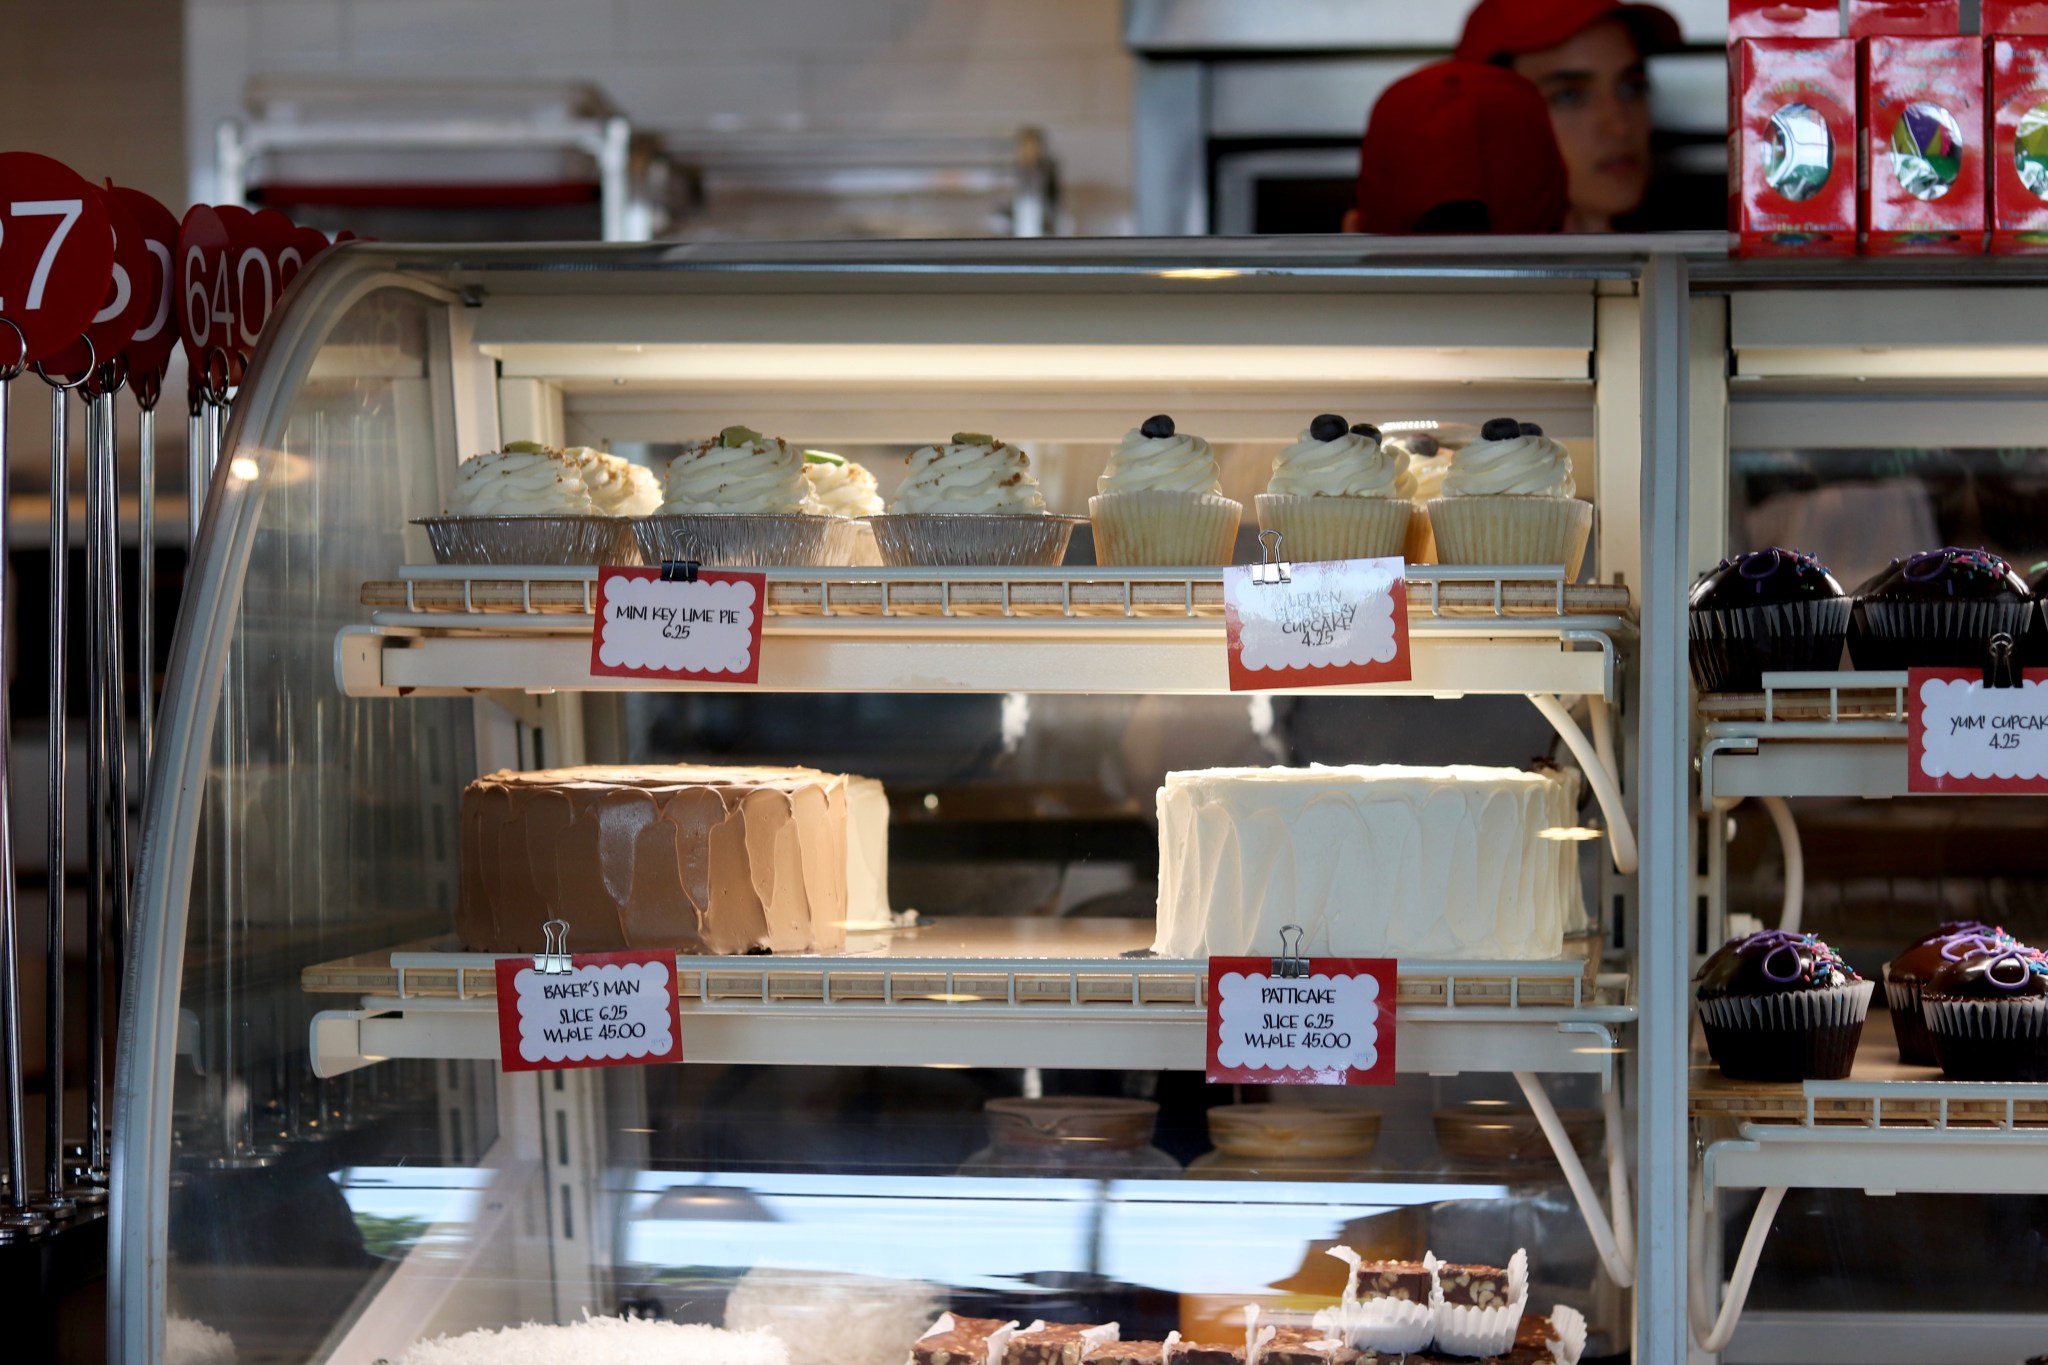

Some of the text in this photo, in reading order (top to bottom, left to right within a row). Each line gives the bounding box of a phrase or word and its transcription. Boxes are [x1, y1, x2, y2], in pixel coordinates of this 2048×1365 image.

[0, 199, 83, 310] 7
[1288, 590, 1341, 608] LEMON
[616, 605, 740, 626] MINI KEY LIME PIE
[1282, 612, 1351, 633] CUPCAKE
[662, 624, 691, 639] 6.25
[1301, 630, 1334, 647] 4.25
[1988, 732, 2020, 749] 4.25
[543, 980, 640, 999] BAKER'S MAN
[1261, 987, 1336, 1004] PATTICAKE
[559, 1005, 628, 1024] SLICE 6.25
[1262, 1013, 1334, 1029] SLICE 6.25
[543, 1022, 646, 1043] WHOLE 45.00
[1245, 1032, 1351, 1049] WHOLE 45.00
